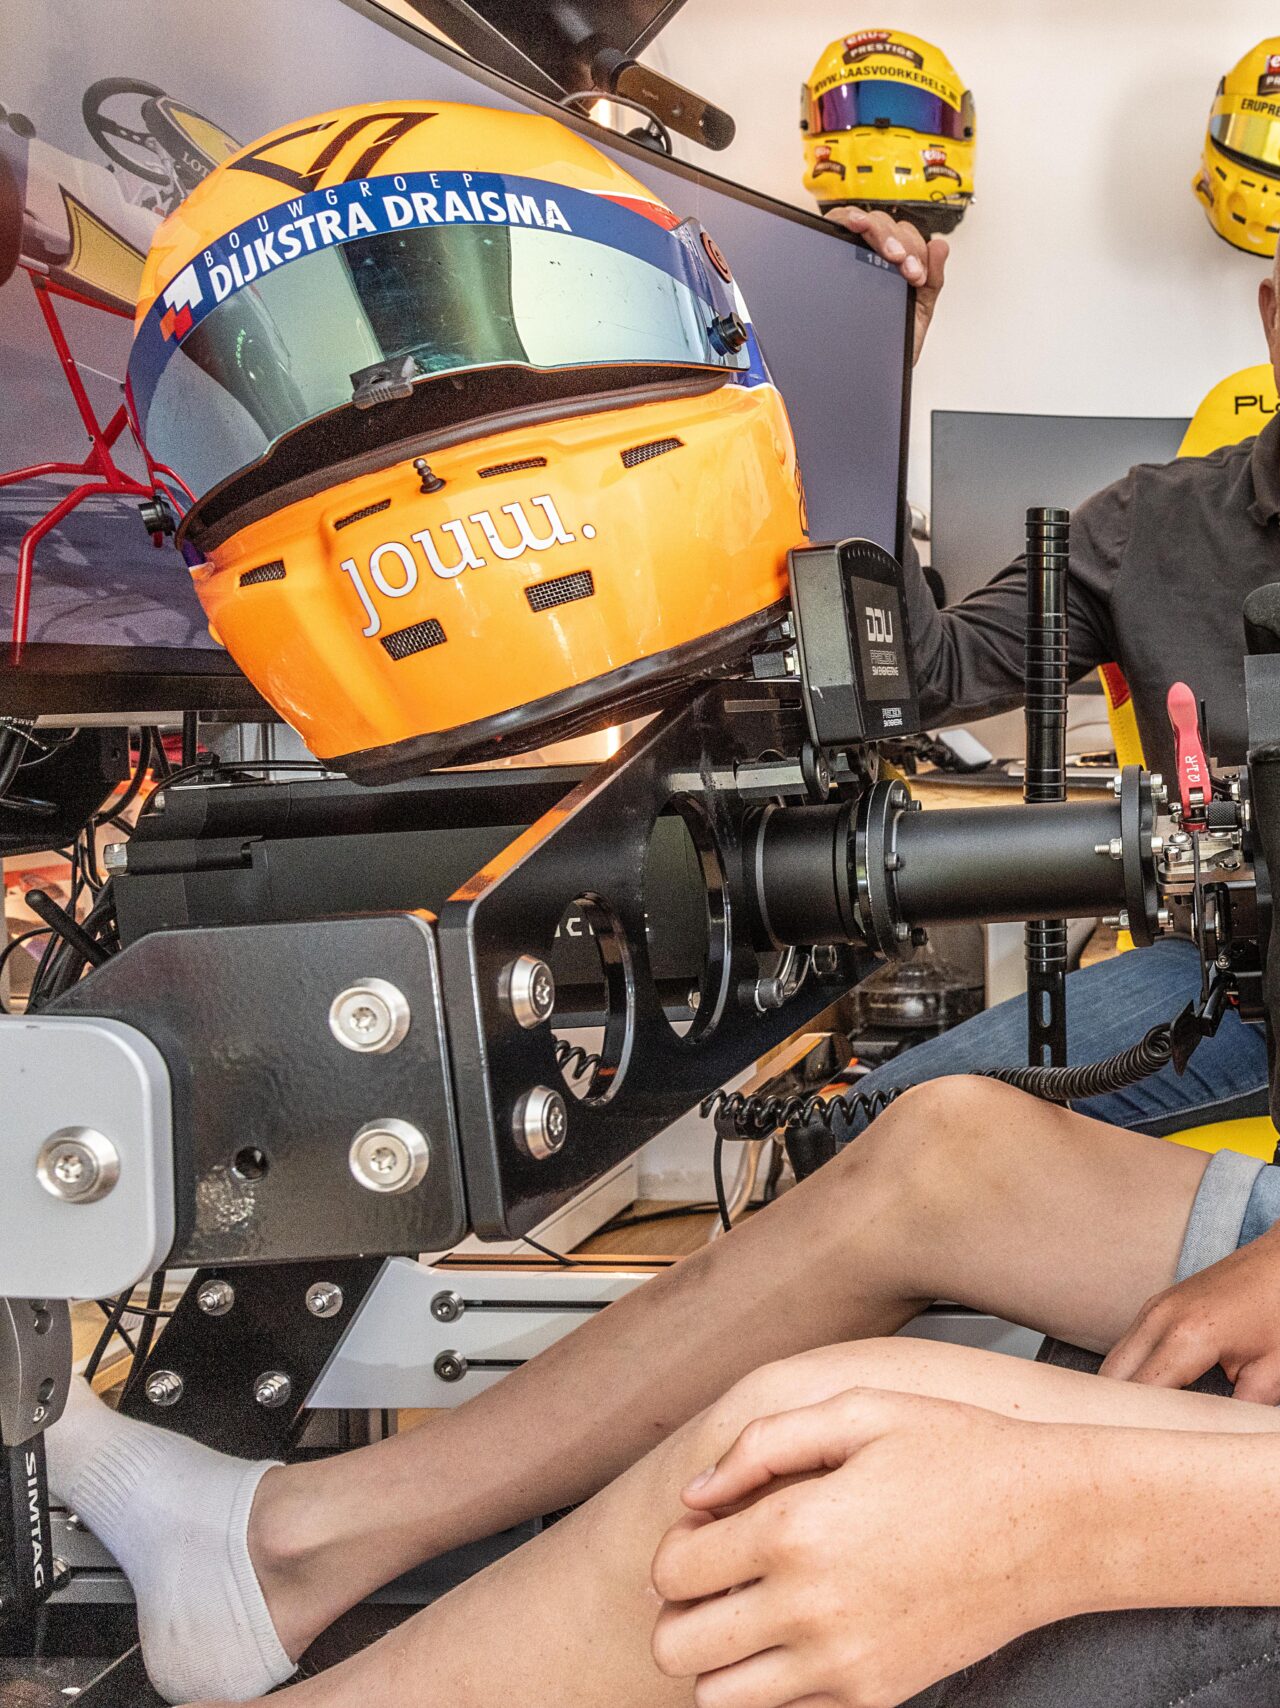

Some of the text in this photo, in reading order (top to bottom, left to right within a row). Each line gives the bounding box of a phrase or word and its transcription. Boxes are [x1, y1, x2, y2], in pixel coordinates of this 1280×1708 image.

[204, 172, 473, 268] BOUWGROEP
[208, 190, 573, 303] DIJKSTRA DRAISMA
[340, 493, 597, 638] jouw.
[25, 1451, 45, 1589] SIMTAG
